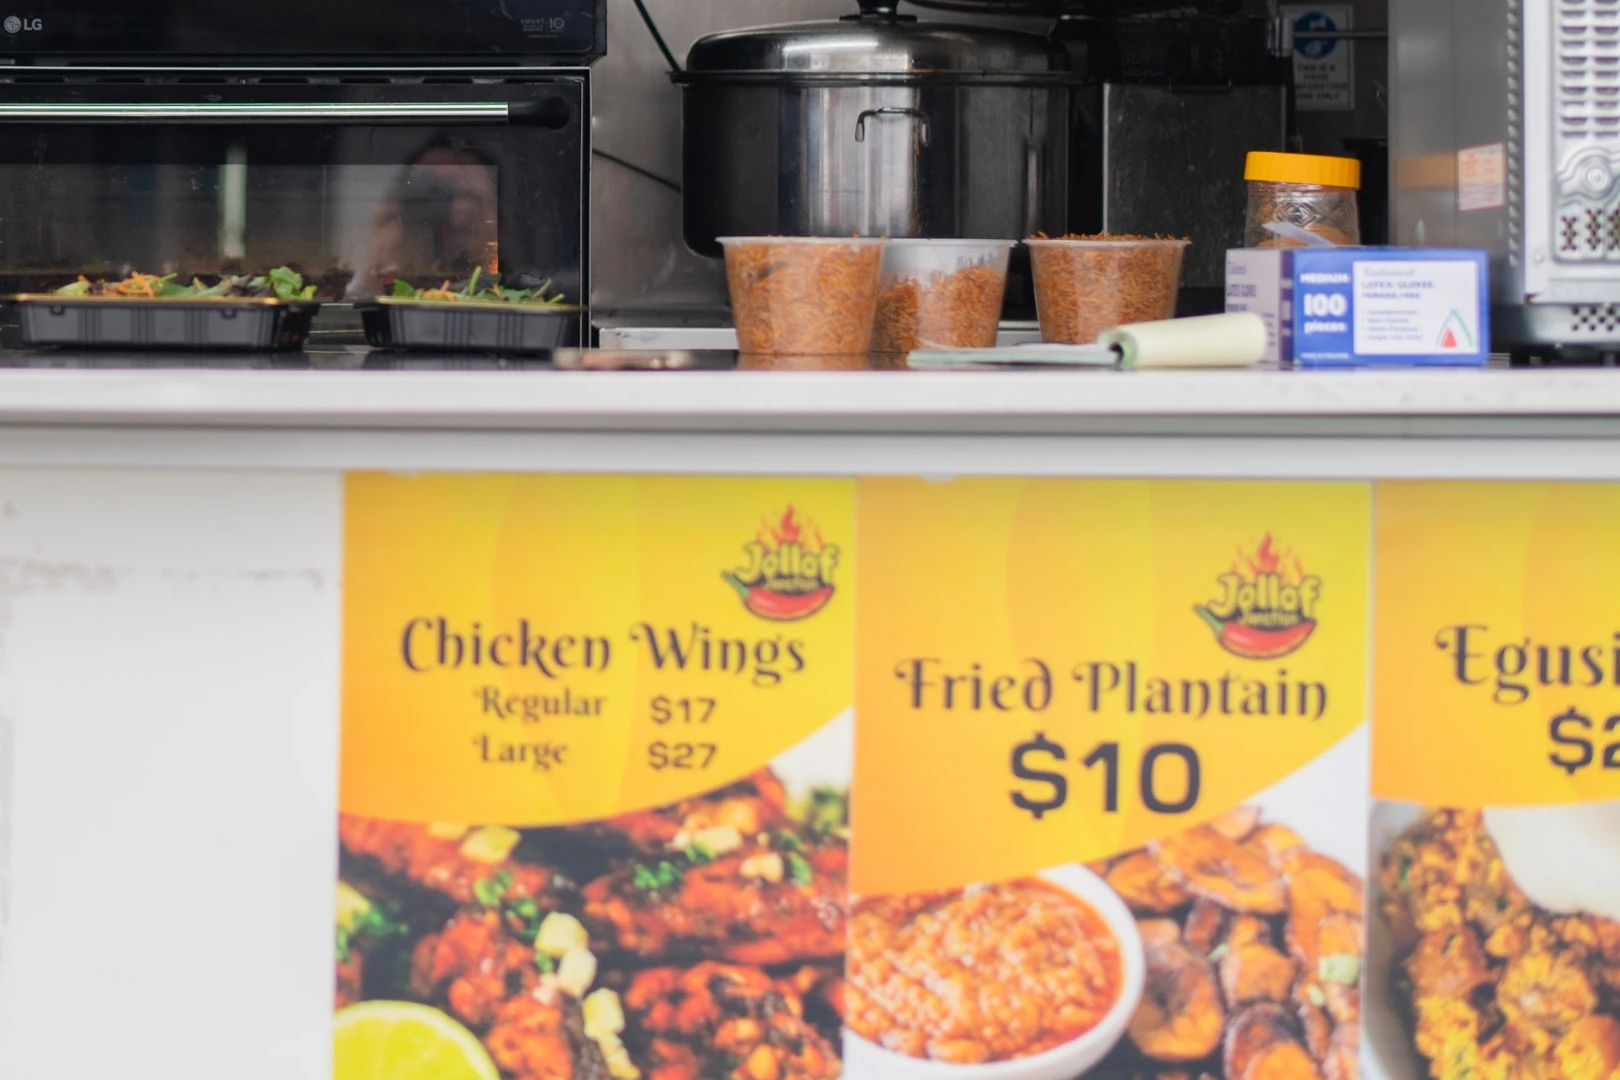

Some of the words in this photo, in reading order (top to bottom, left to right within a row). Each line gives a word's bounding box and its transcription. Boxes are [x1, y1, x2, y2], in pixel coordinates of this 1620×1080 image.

[23, 18, 43, 31] LG
[1303, 293, 1347, 317] 100
[1362, 281, 1394, 289] LATEX
[1397, 281, 1434, 289] GLOVES
[1303, 320, 1347, 335] pieces
[733, 540, 842, 585] Jollof
[1206, 572, 1323, 620] Jollof
[401, 615, 611, 678] Chicken
[630, 620, 806, 688] Wings
[1434, 624, 1620, 706] Egusi
[473, 686, 606, 724] Regular
[650, 694, 718, 727] $17
[894, 657, 1053, 712] Fried
[1071, 660, 1328, 720] Plantain
[472, 733, 569, 772] Large
[648, 740, 718, 772] $27
[1009, 731, 1202, 819] $10
